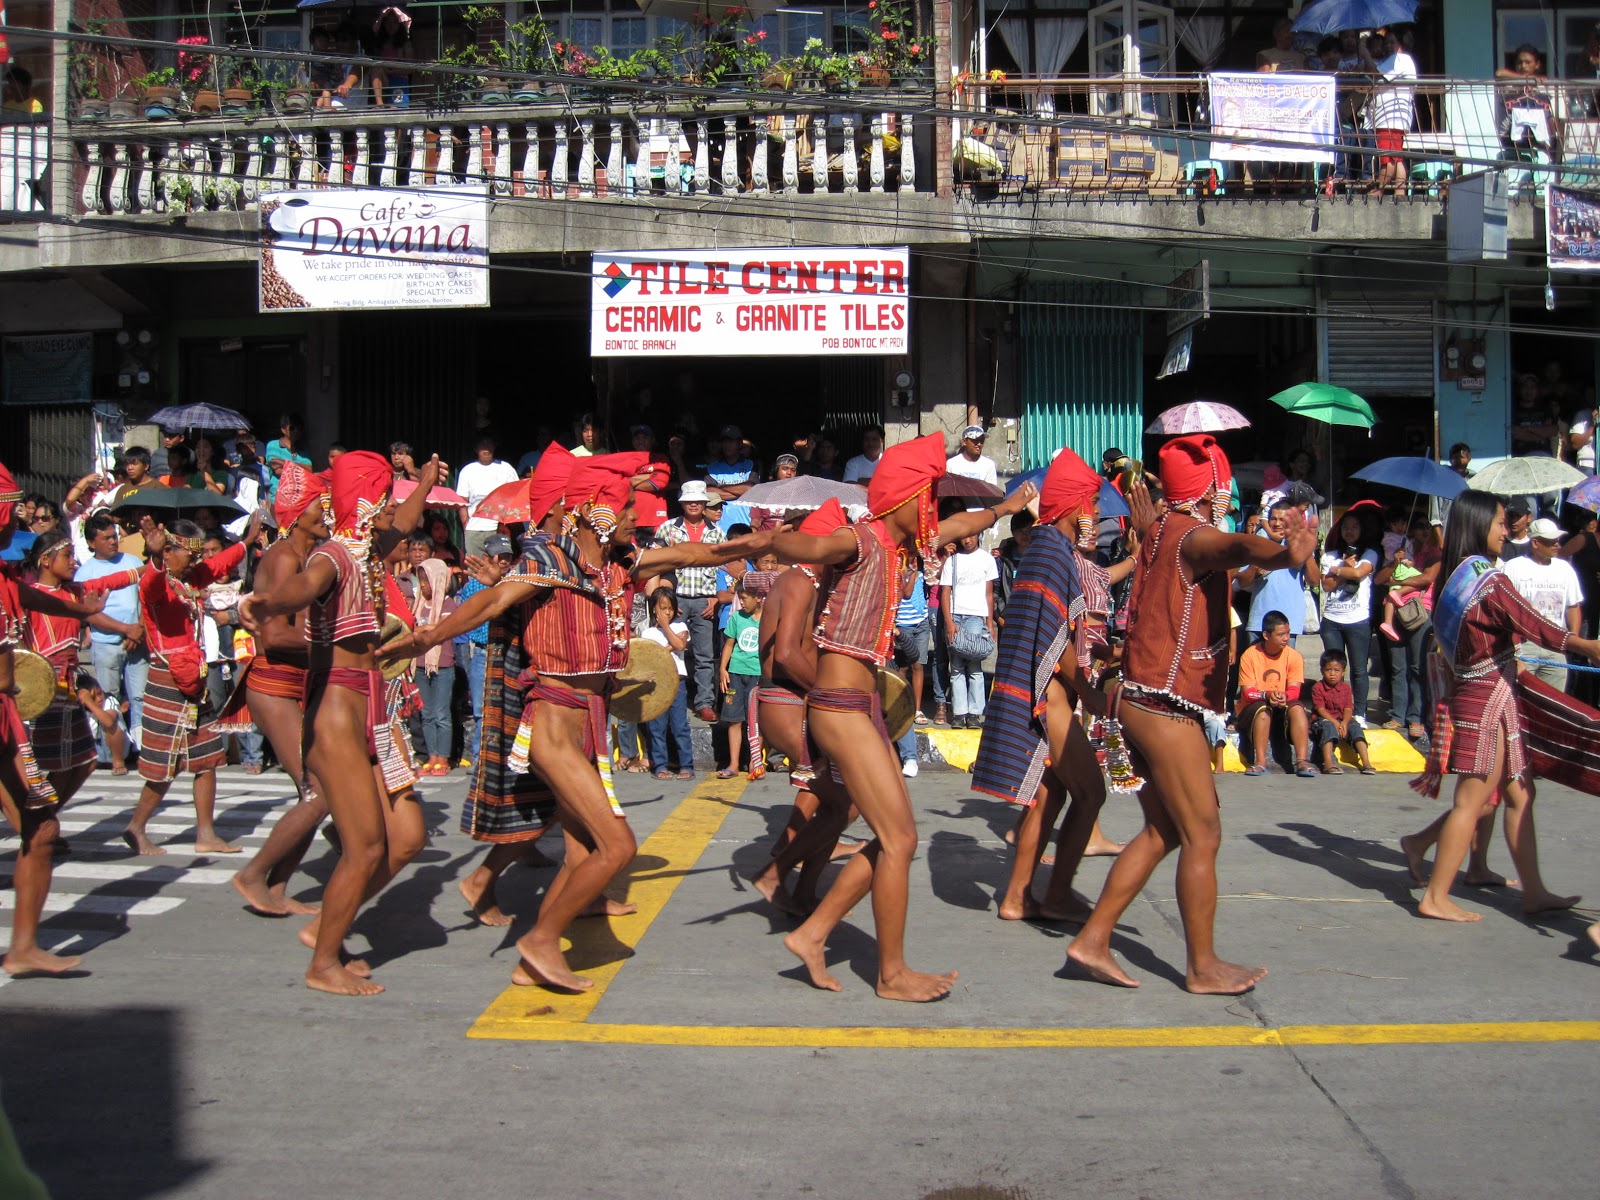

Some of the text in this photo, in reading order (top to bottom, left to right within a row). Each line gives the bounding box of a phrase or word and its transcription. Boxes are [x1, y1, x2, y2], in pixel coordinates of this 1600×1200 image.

[1213, 83, 1328, 99] MAXIMO B. DALOG
[299, 217, 475, 256] Davana
[303, 259, 319, 270] We
[321, 259, 342, 270] take
[345, 258, 372, 271] pride
[375, 258, 385, 268] in
[387, 258, 404, 267] our
[406, 280, 445, 288] BIRTHDAY
[631, 260, 906, 295] TILE CENTER
[406, 288, 446, 296] SPECIALTY
[606, 303, 905, 333] CERAMIC & GRANITE TILES
[51, 339, 65, 351] EYE
[67, 336, 92, 350] CLINIC
[605, 340, 639, 350] BONTOC
[642, 339, 677, 350] BRANCH
[842, 337, 878, 348] BONTOC
